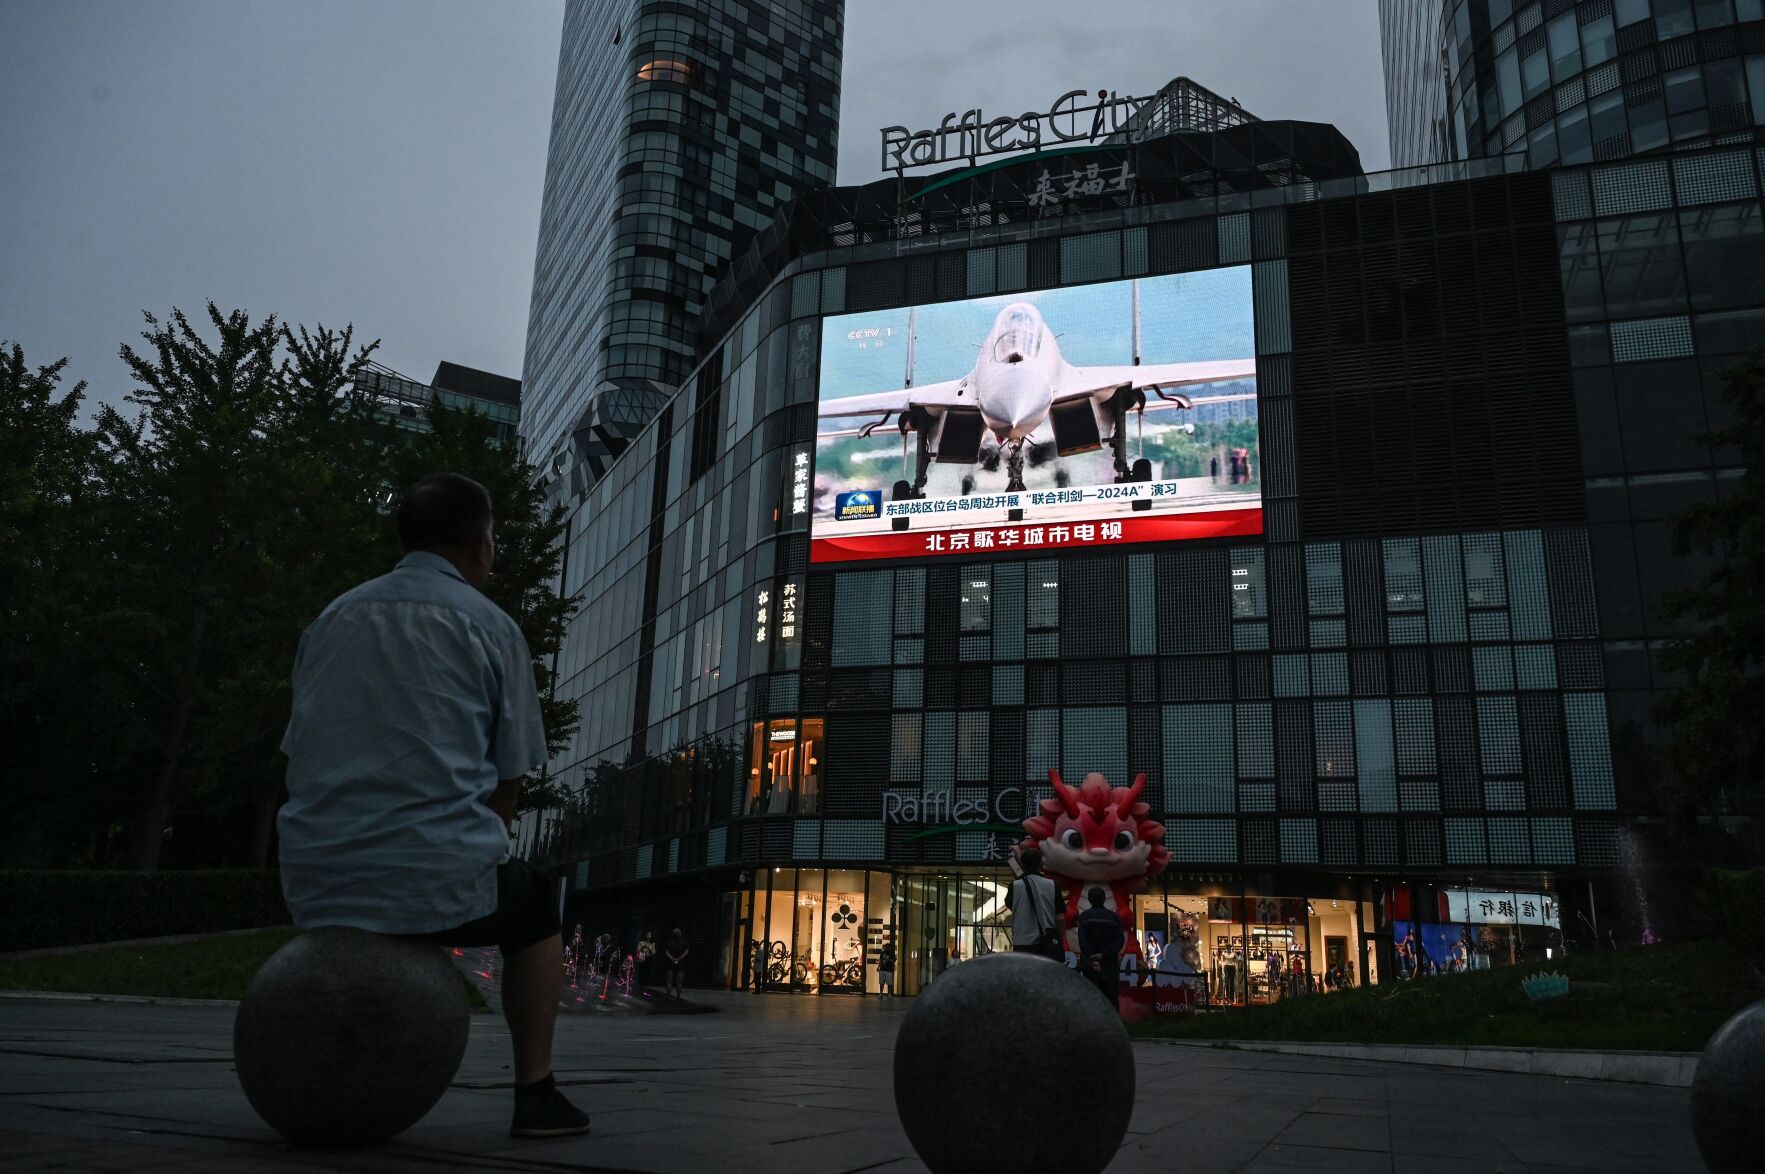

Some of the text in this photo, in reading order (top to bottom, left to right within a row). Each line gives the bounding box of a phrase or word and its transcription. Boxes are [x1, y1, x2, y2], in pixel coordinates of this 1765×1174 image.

[880, 89, 1162, 171] Raffles City
[842, 504, 875, 515] 新闻联播
[925, 522, 1122, 551] 北京歌华城市电视
[782, 583, 797, 638] 苏式汤面
[882, 788, 1041, 825] Raffles Cit
